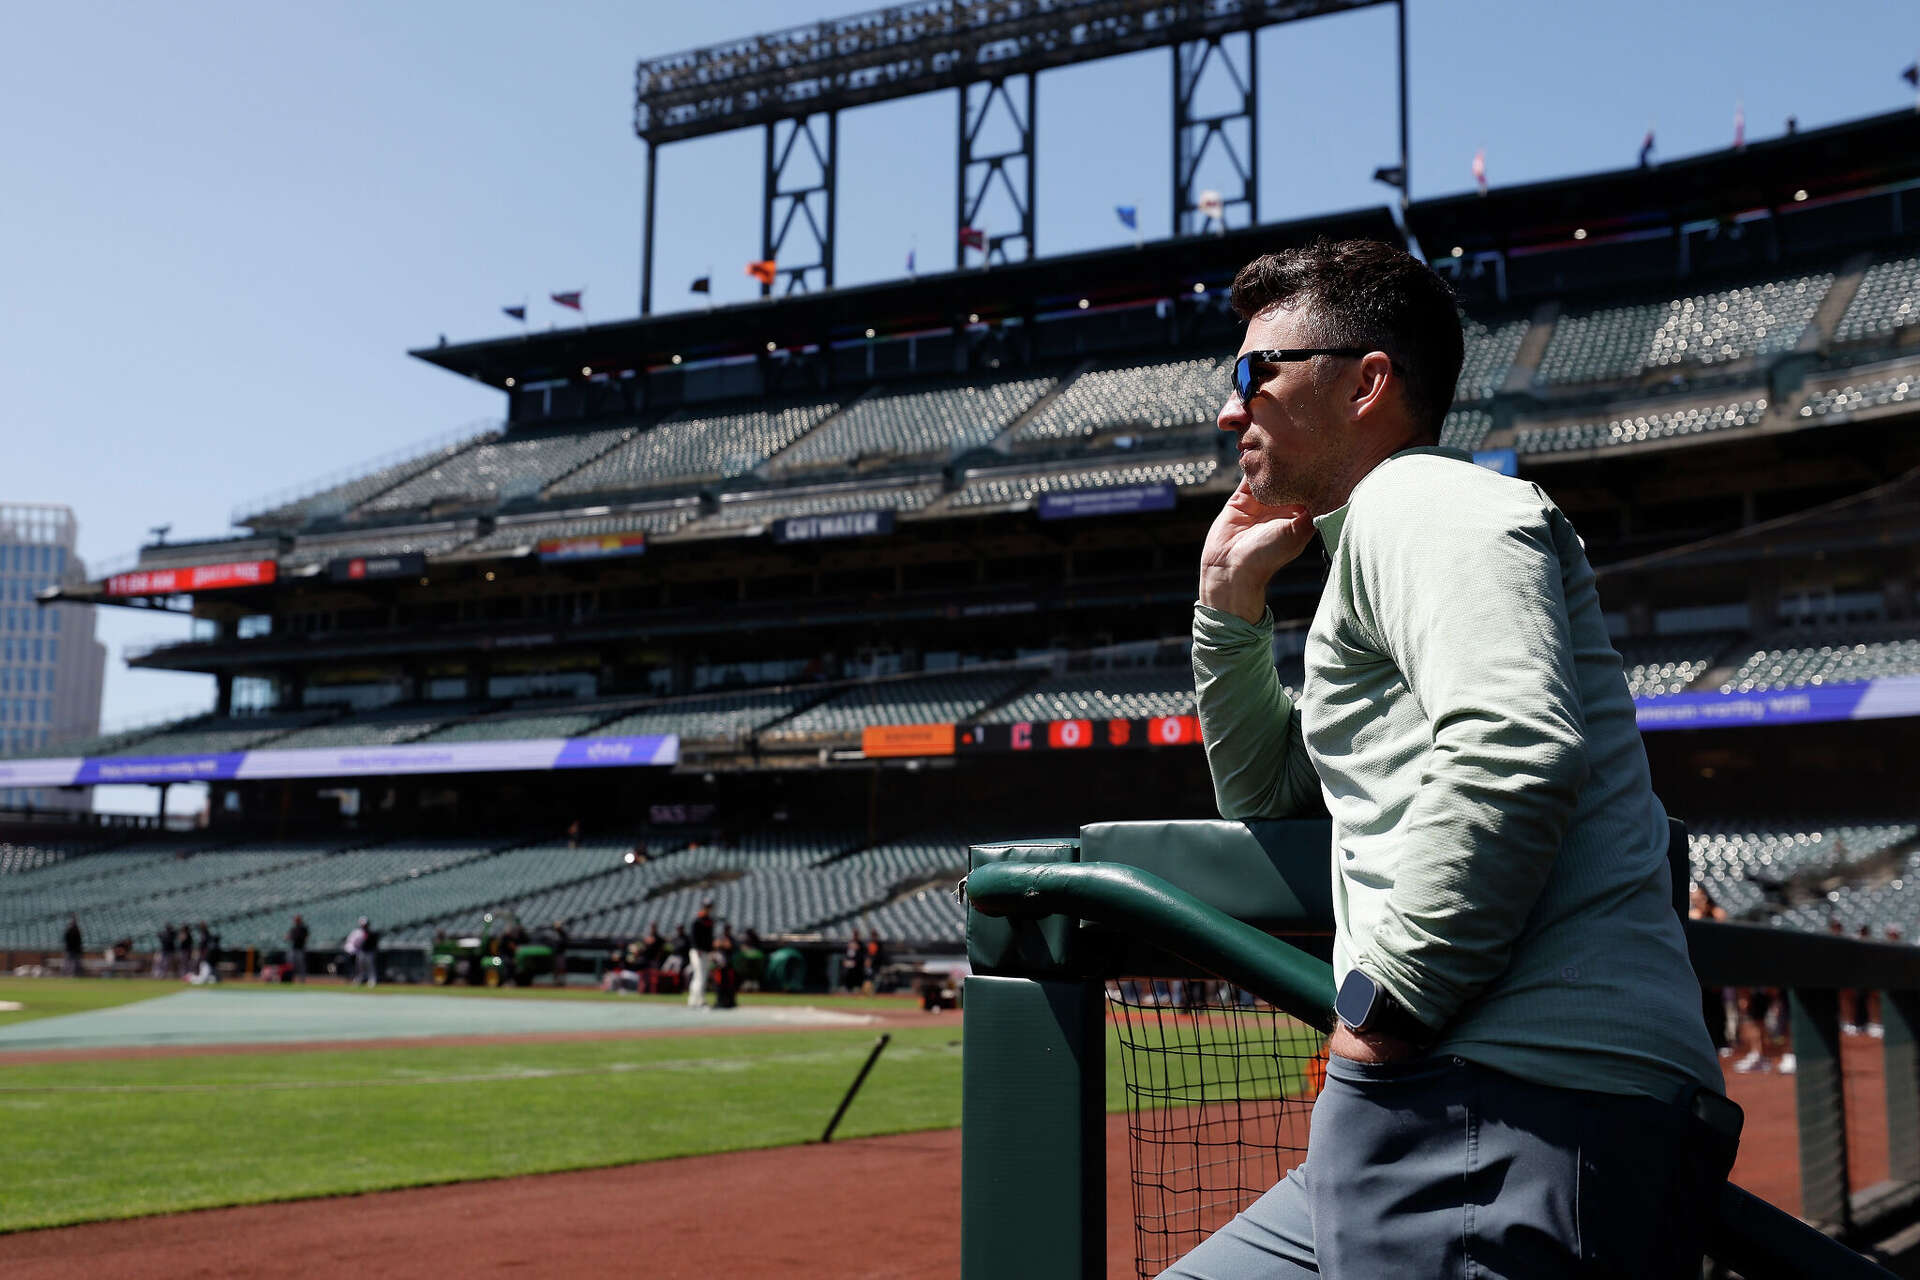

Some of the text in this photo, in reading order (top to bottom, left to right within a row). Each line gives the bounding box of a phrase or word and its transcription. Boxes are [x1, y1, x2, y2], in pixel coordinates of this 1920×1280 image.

[1011, 721, 1032, 749] C
[1061, 721, 1080, 746] 0
[1161, 717, 1181, 743] 0
